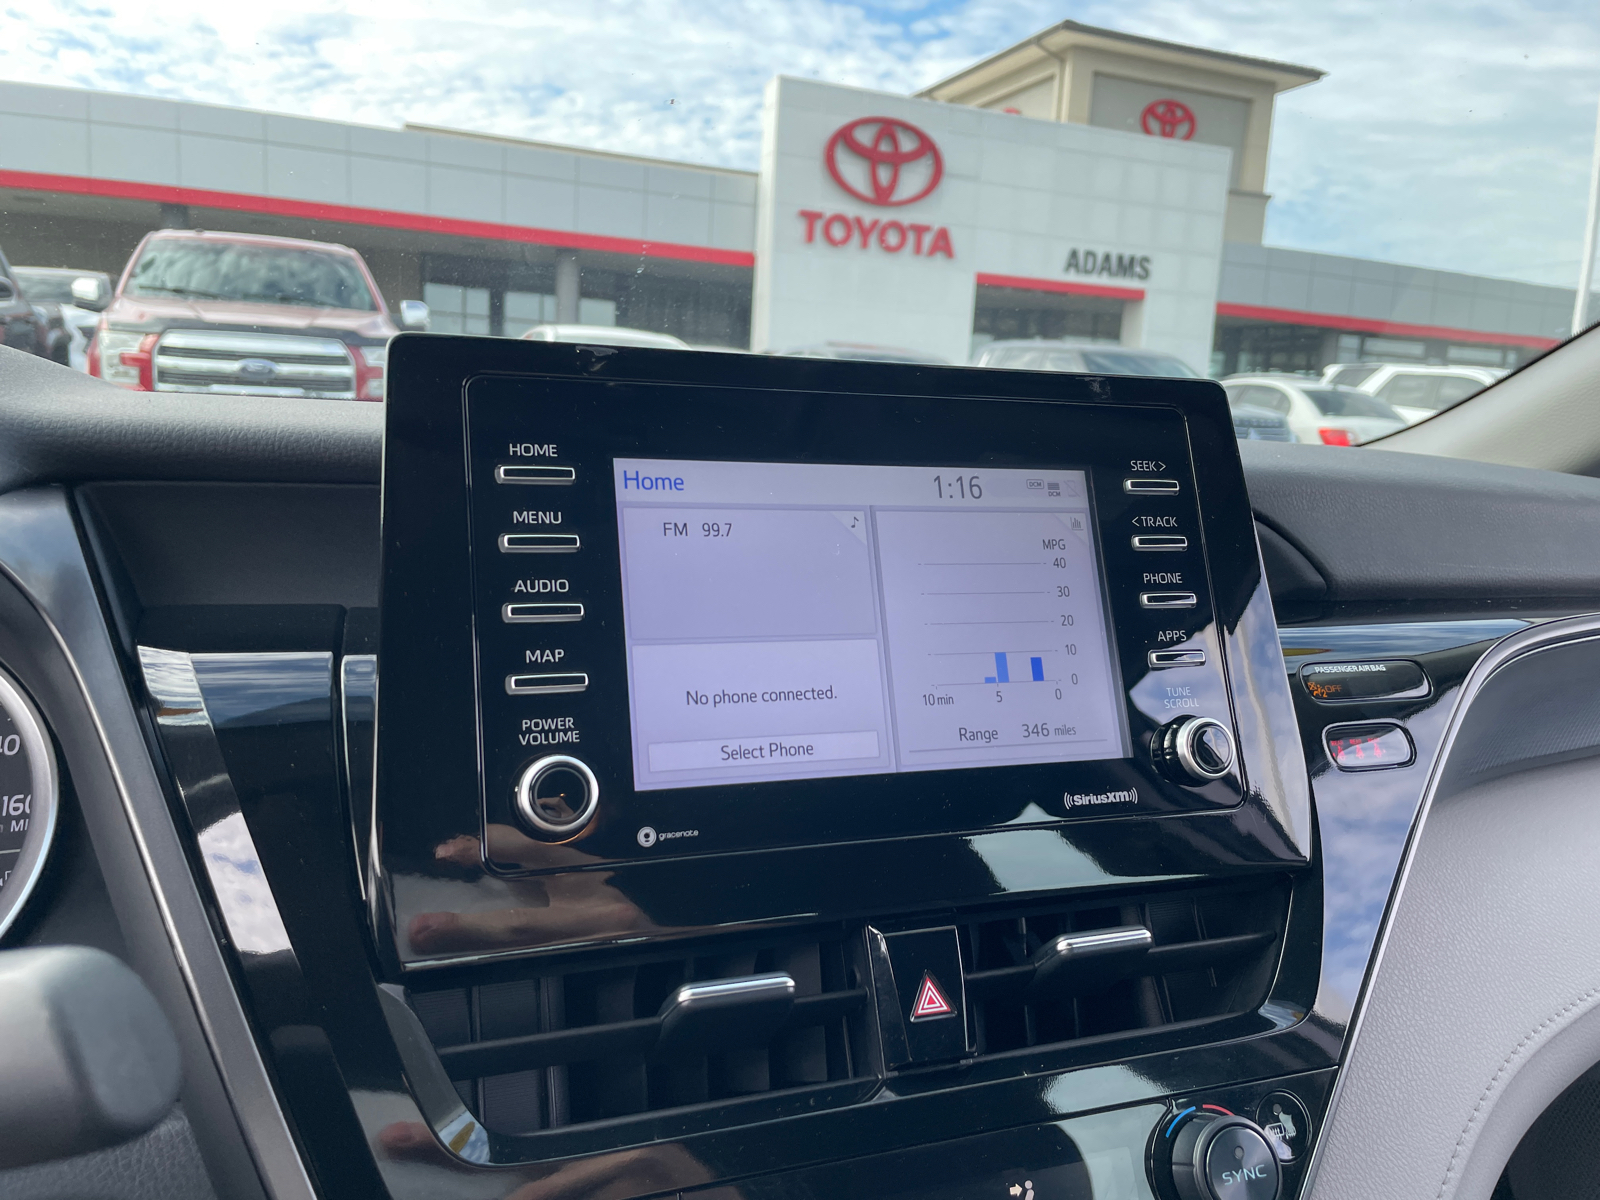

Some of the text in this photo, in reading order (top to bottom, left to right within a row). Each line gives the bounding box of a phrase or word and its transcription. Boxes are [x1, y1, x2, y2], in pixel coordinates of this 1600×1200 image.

[799, 209, 955, 260] TOYOTA
[1064, 248, 1153, 281] ADAMS
[509, 443, 558, 457] HOME
[623, 470, 685, 491] Home
[933, 475, 983, 500] 1:16
[513, 511, 562, 524] MENU
[663, 522, 733, 537] FM 99.7
[1042, 539, 1066, 550] MPG
[1053, 557, 1067, 569] 40
[1143, 573, 1183, 584] PHONE
[514, 579, 570, 593] AUDIO
[1056, 586, 1070, 597] 30
[1060, 615, 1074, 626] 20
[1157, 630, 1187, 642] APPS
[1065, 644, 1077, 655] 10
[525, 649, 565, 664] MAP
[1314, 665, 1358, 673] PASSENGER
[1071, 673, 1079, 685] 0
[1055, 688, 1062, 700] 0
[1166, 686, 1192, 697] TUNE
[1325, 685, 1342, 693] OFF
[686, 685, 838, 708] No phone connected.
[922, 693, 954, 706] 10 min
[996, 691, 1003, 703] 5
[1164, 698, 1200, 709] SCROLL
[522, 717, 574, 731] POWER
[519, 731, 580, 745] VOLUME
[958, 722, 1077, 743] Range 346 miles
[721, 742, 814, 761] Select Phone
[659, 829, 699, 842] gracenote
[1222, 1164, 1267, 1184] SYNC
